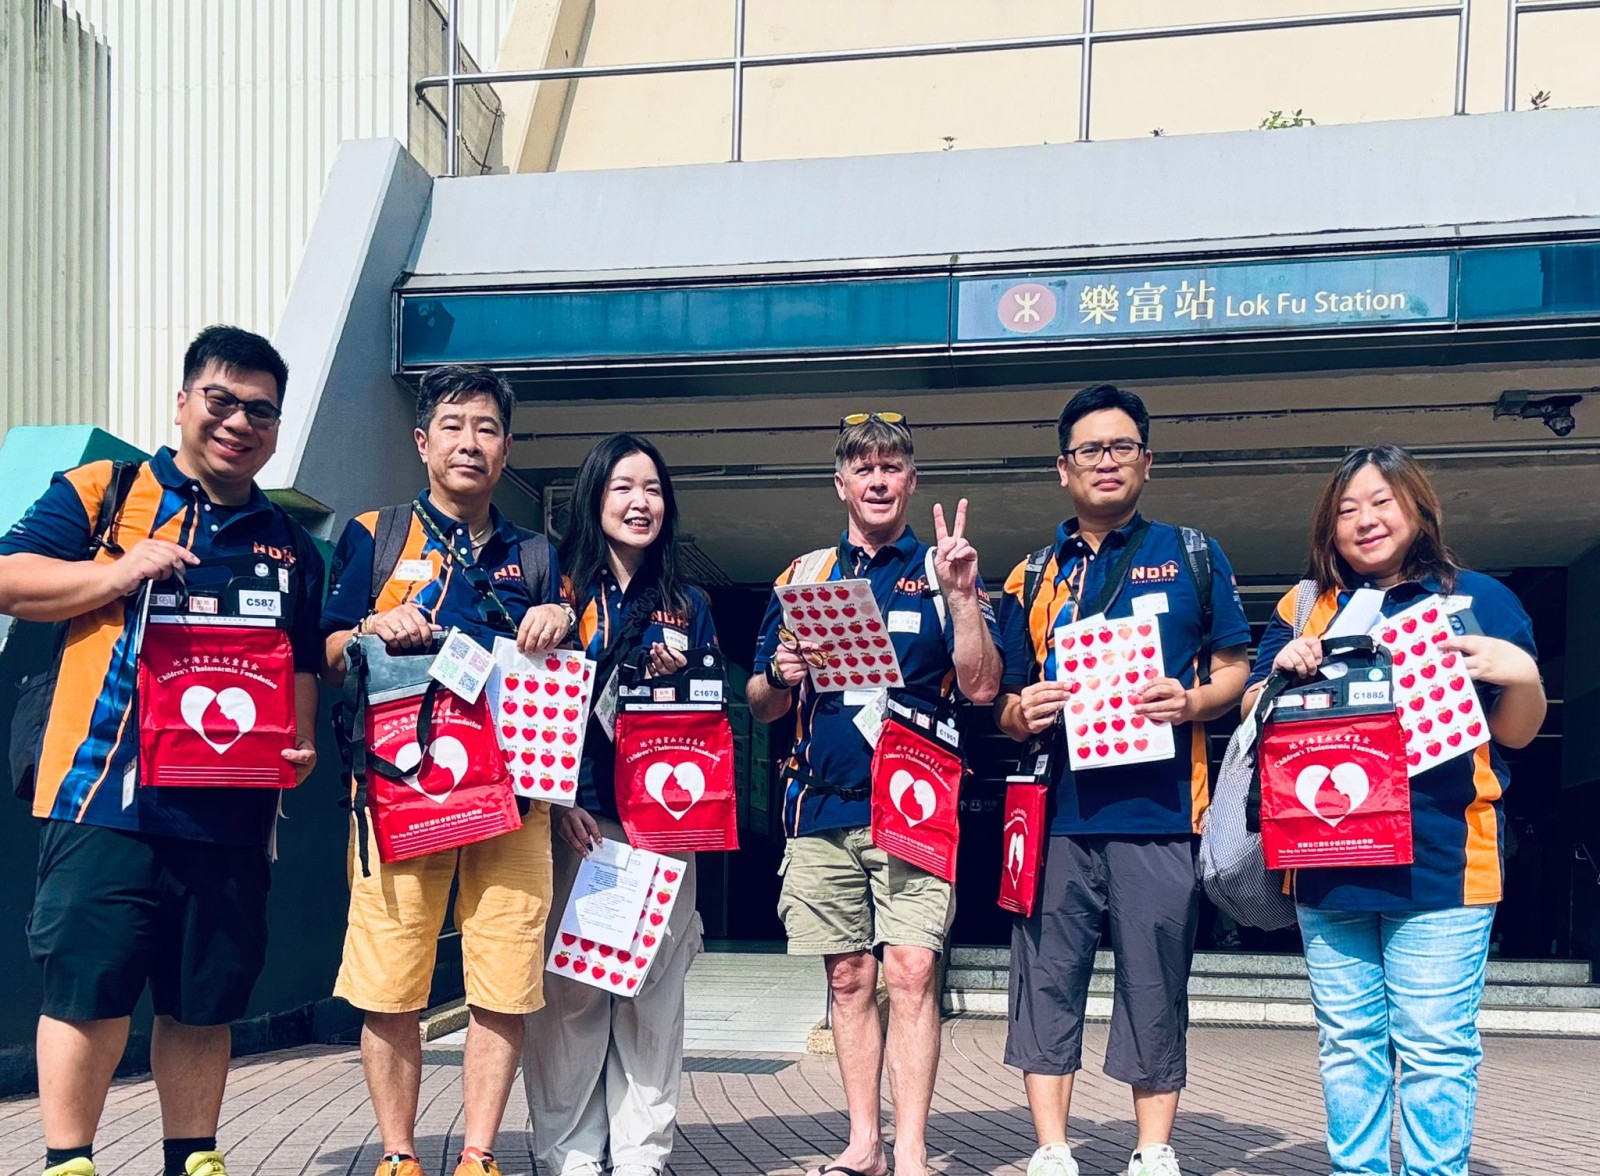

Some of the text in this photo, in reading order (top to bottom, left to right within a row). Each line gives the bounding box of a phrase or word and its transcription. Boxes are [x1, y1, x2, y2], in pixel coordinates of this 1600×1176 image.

[1078, 280, 1216, 325] 樂富站
[1225, 289, 1406, 317] Lok Fu Station
[494, 564, 521, 580] ND
[1132, 564, 1178, 579] NDH
[246, 598, 274, 607] C587
[157, 668, 189, 683] Children's
[240, 669, 278, 690] Foundation
[445, 717, 482, 731] Foundation
